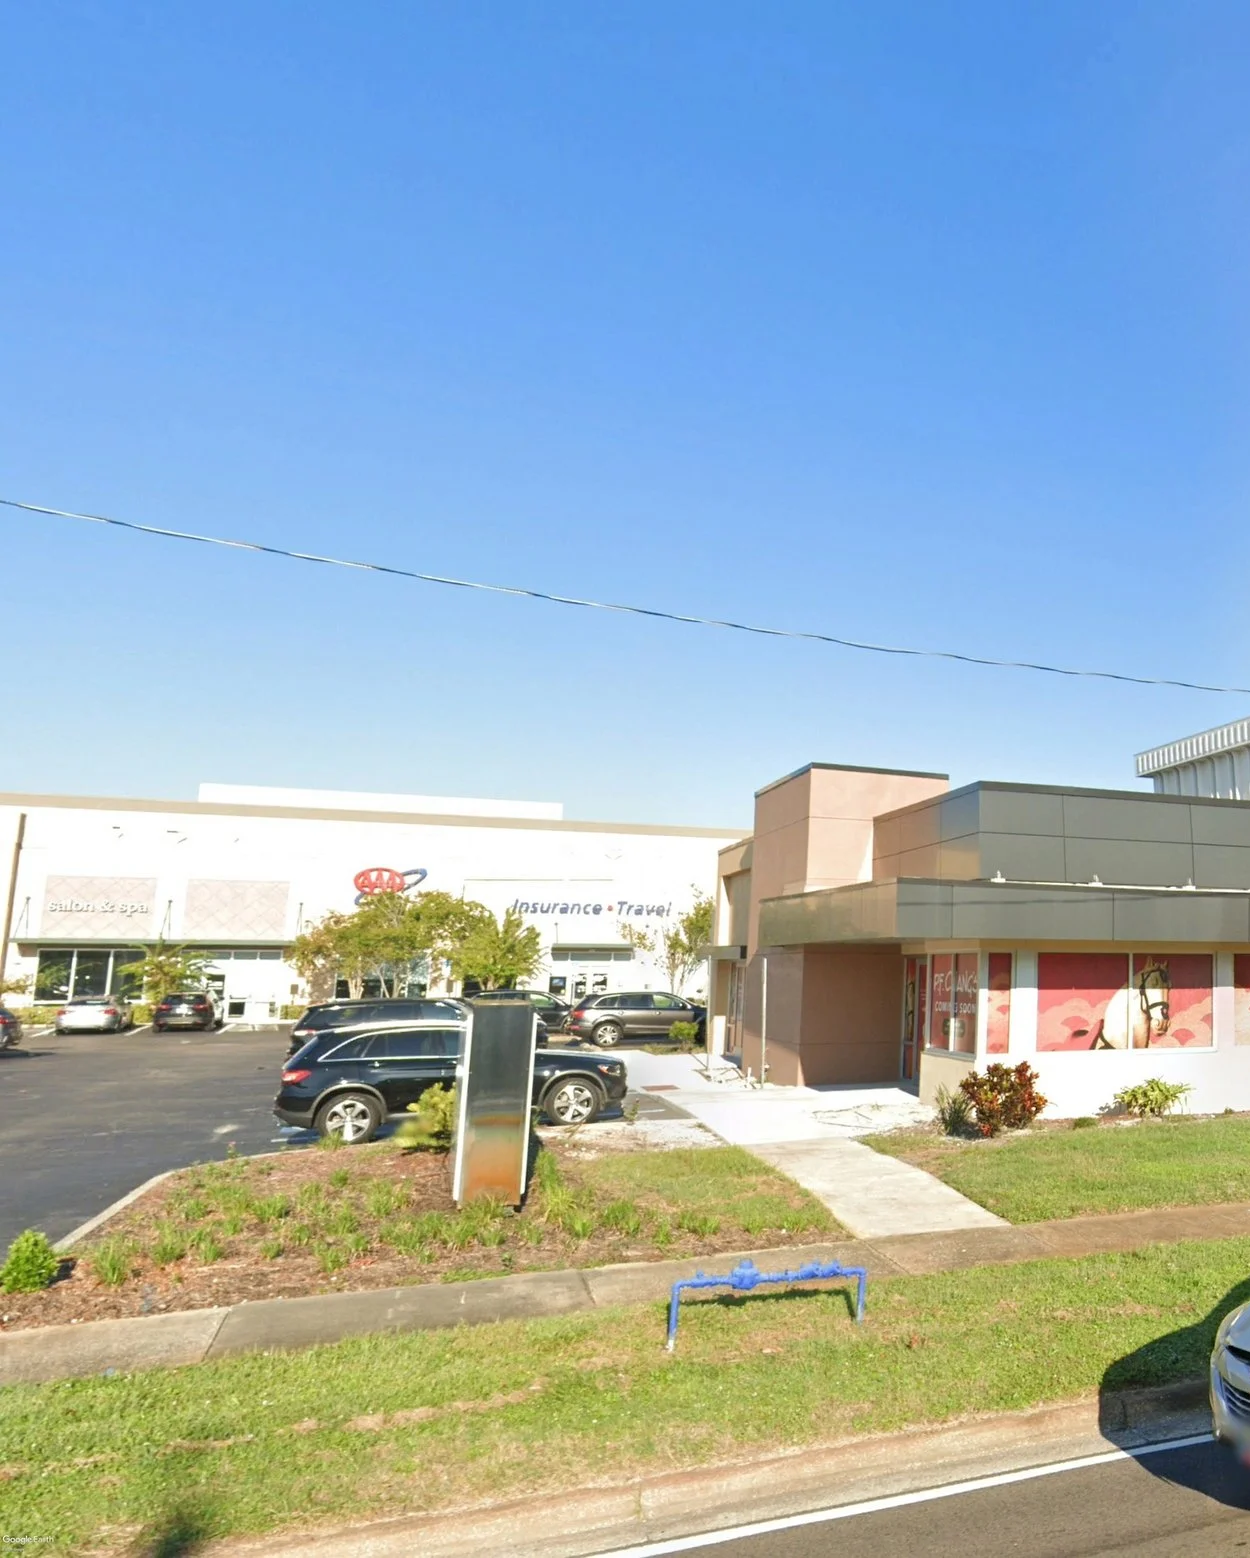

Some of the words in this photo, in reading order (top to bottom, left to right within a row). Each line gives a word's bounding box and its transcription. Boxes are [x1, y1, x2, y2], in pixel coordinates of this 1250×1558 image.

[355, 868, 404, 894] AAA
[48, 900, 96, 913] salon
[100, 900, 115, 913] &
[119, 902, 149, 918] spa
[512, 899, 603, 915] Insurance
[617, 901, 672, 917] Travel
